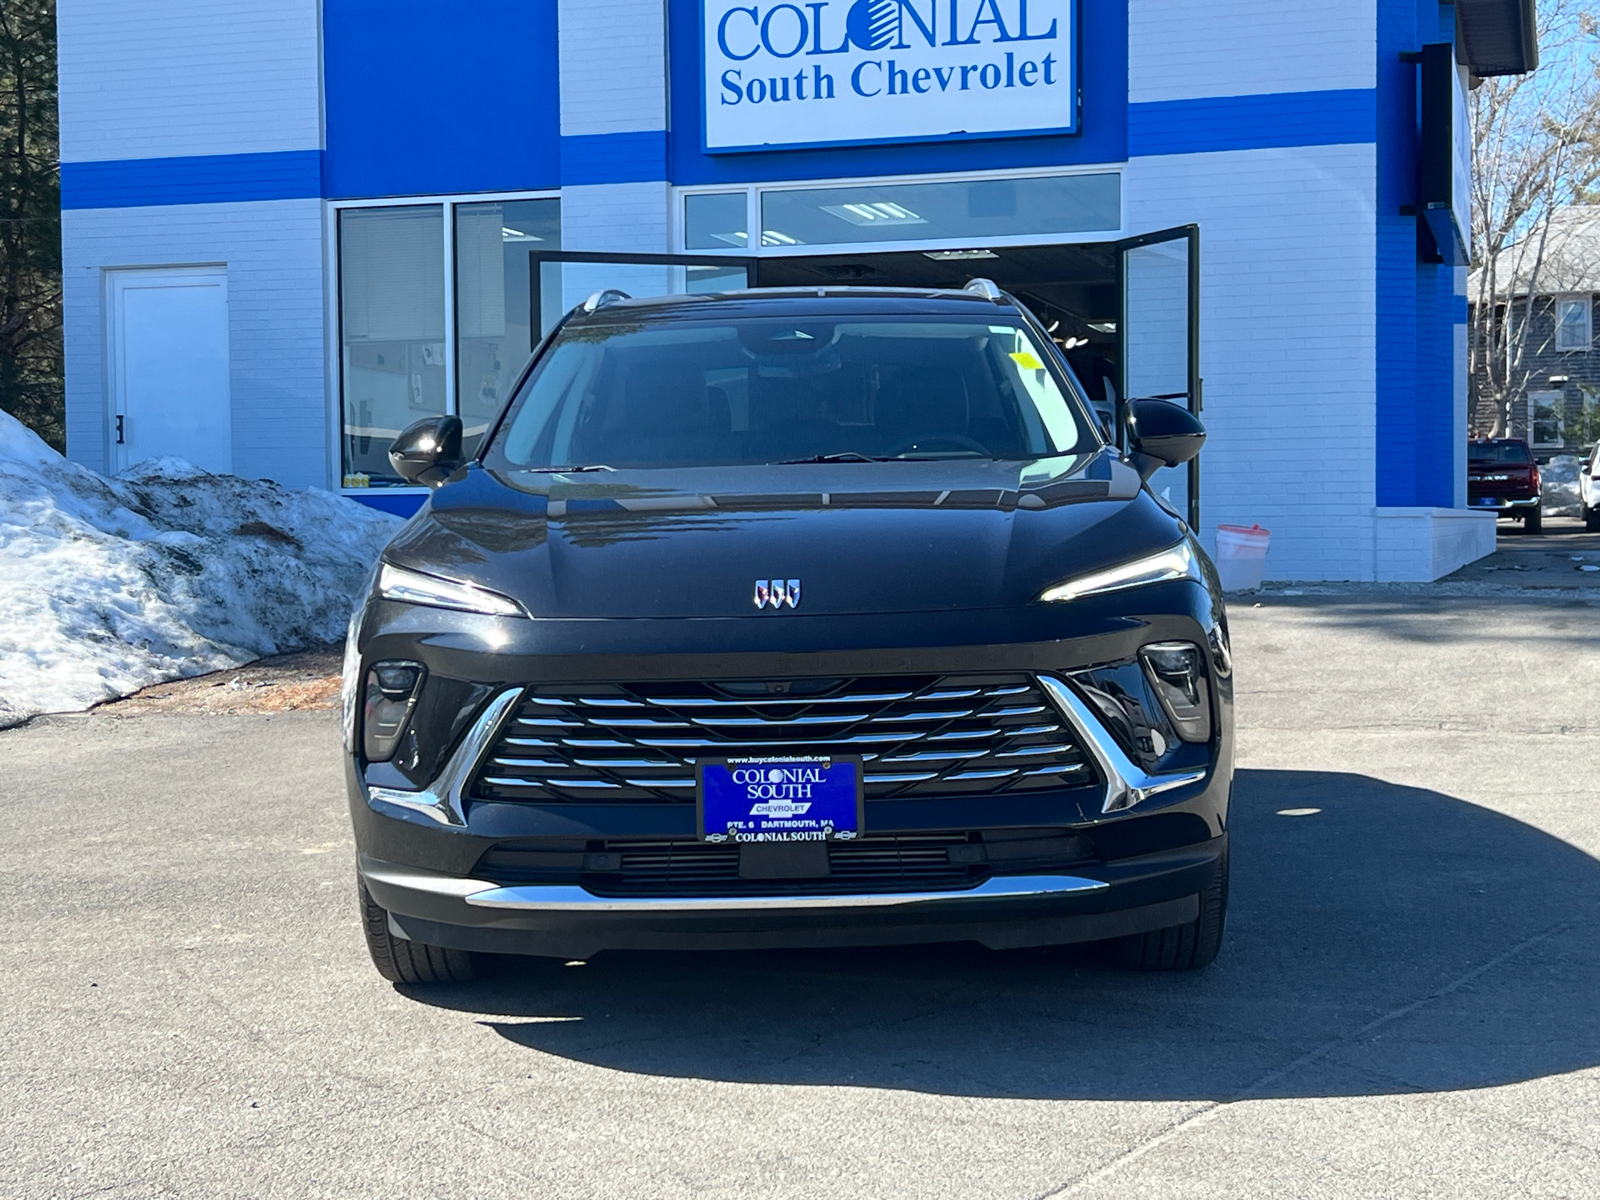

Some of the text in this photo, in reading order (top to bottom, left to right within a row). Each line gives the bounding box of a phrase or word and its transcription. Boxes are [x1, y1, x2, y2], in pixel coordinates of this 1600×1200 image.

[717, 0, 1058, 61] COLONIAL
[720, 51, 1058, 106] South Chevrolet
[727, 755, 831, 765] www.buycolonialsouth.com
[732, 768, 827, 784] COLONIAL
[747, 784, 812, 799] SOUTH
[756, 804, 805, 812] CHEVROLET
[748, 821, 755, 829] 6
[761, 819, 819, 829] DARTMOUTH,
[820, 819, 834, 828] MA
[735, 831, 826, 843] COLONIAL SOUTH
